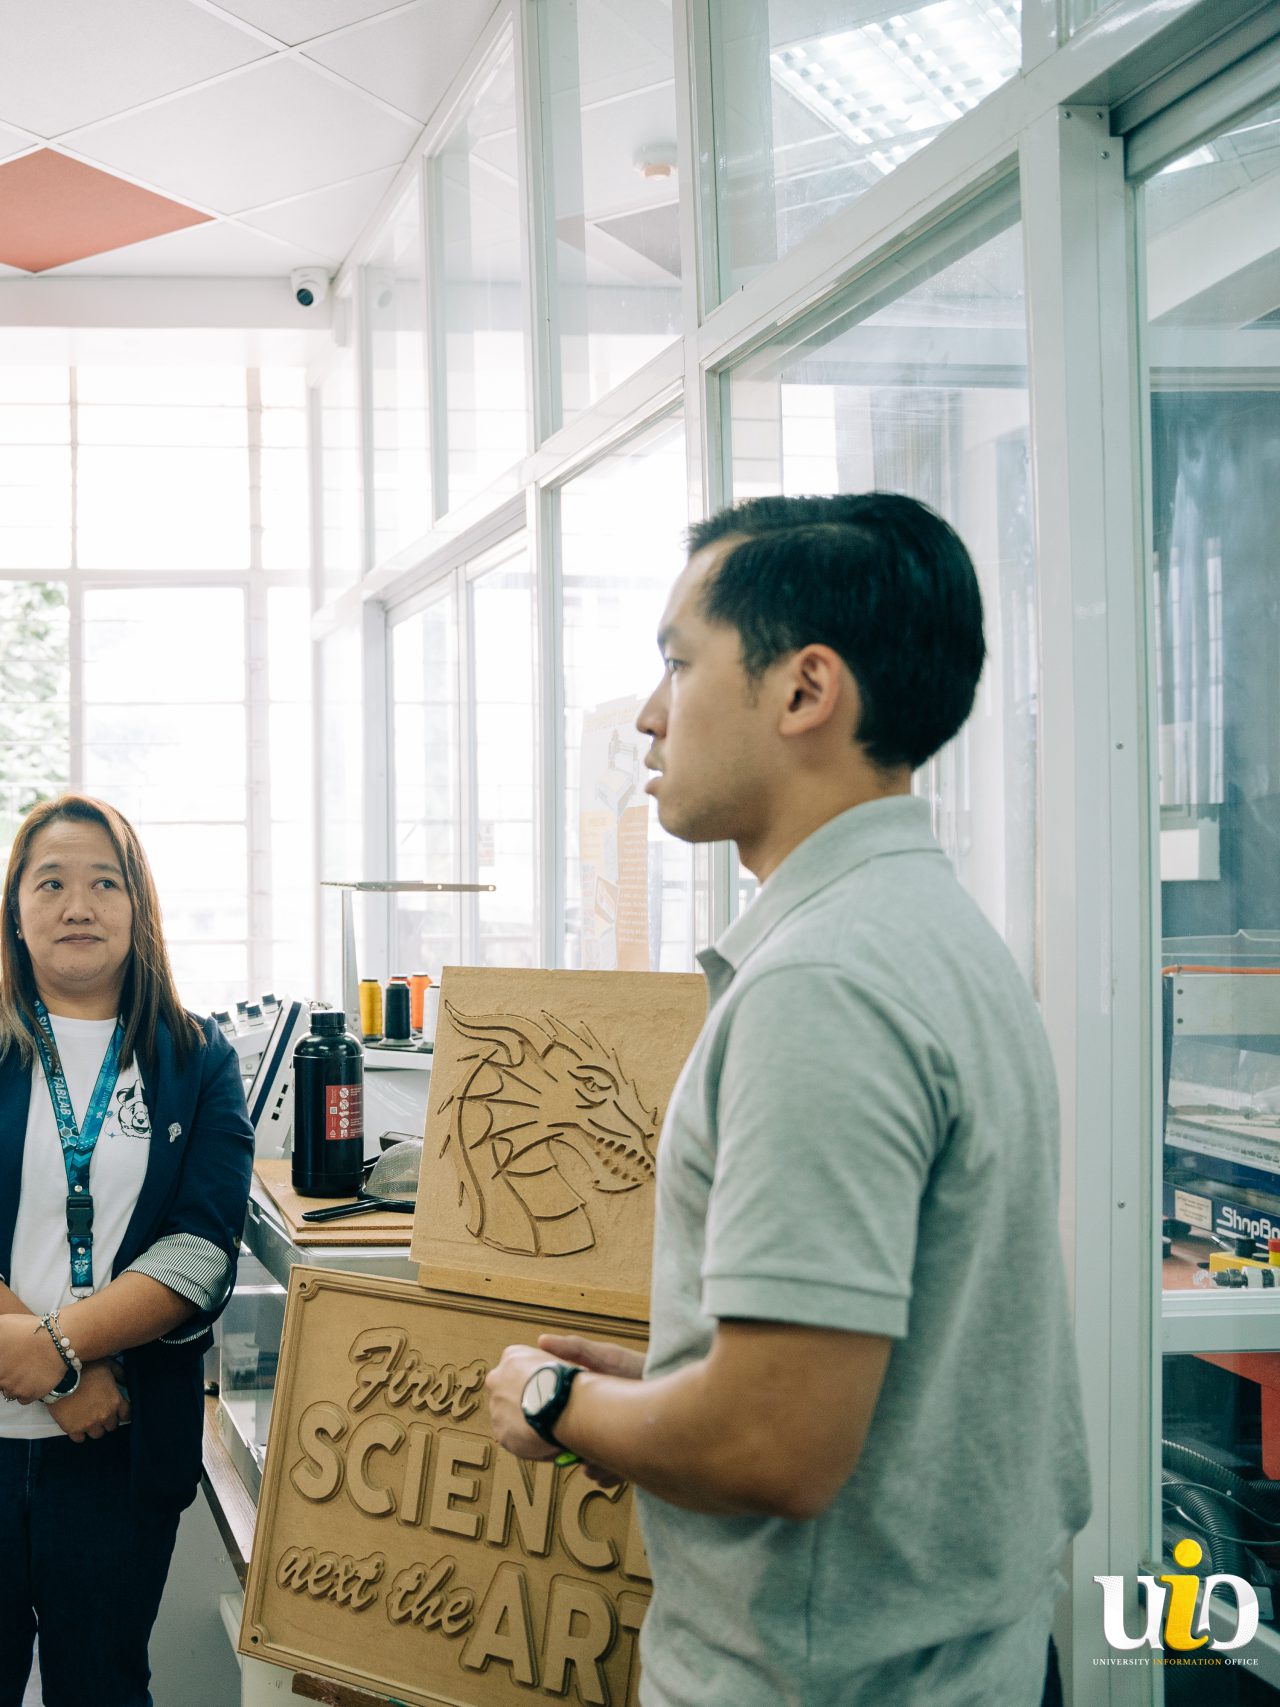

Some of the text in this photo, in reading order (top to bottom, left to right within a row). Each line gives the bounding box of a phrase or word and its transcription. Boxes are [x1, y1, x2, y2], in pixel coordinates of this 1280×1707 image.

[53, 1076, 72, 1116] FABLAB
[349, 1328, 488, 1421] First
[278, 1547, 384, 1612] next
[387, 1556, 477, 1640] the
